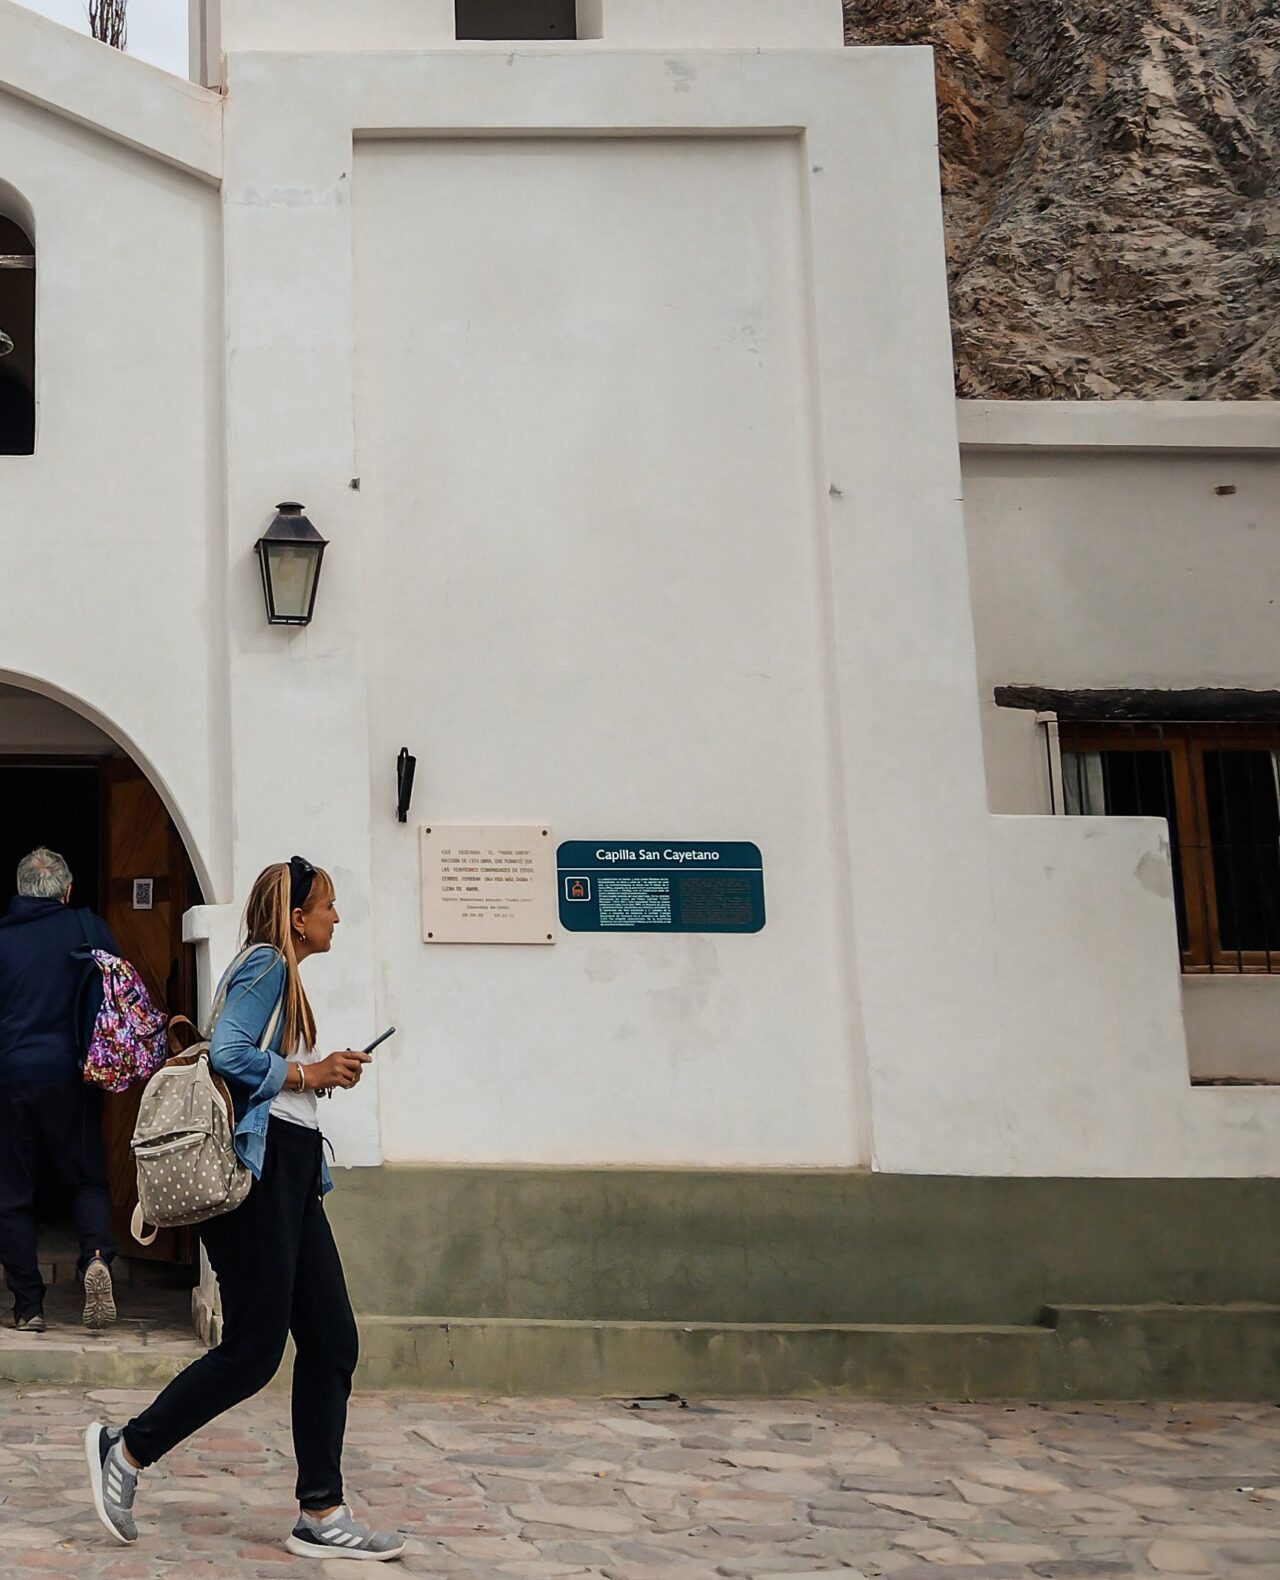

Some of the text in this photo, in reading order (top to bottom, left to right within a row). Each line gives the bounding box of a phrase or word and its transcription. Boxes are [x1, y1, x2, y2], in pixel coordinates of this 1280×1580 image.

[595, 849, 720, 863] Capilla San Cayetano
